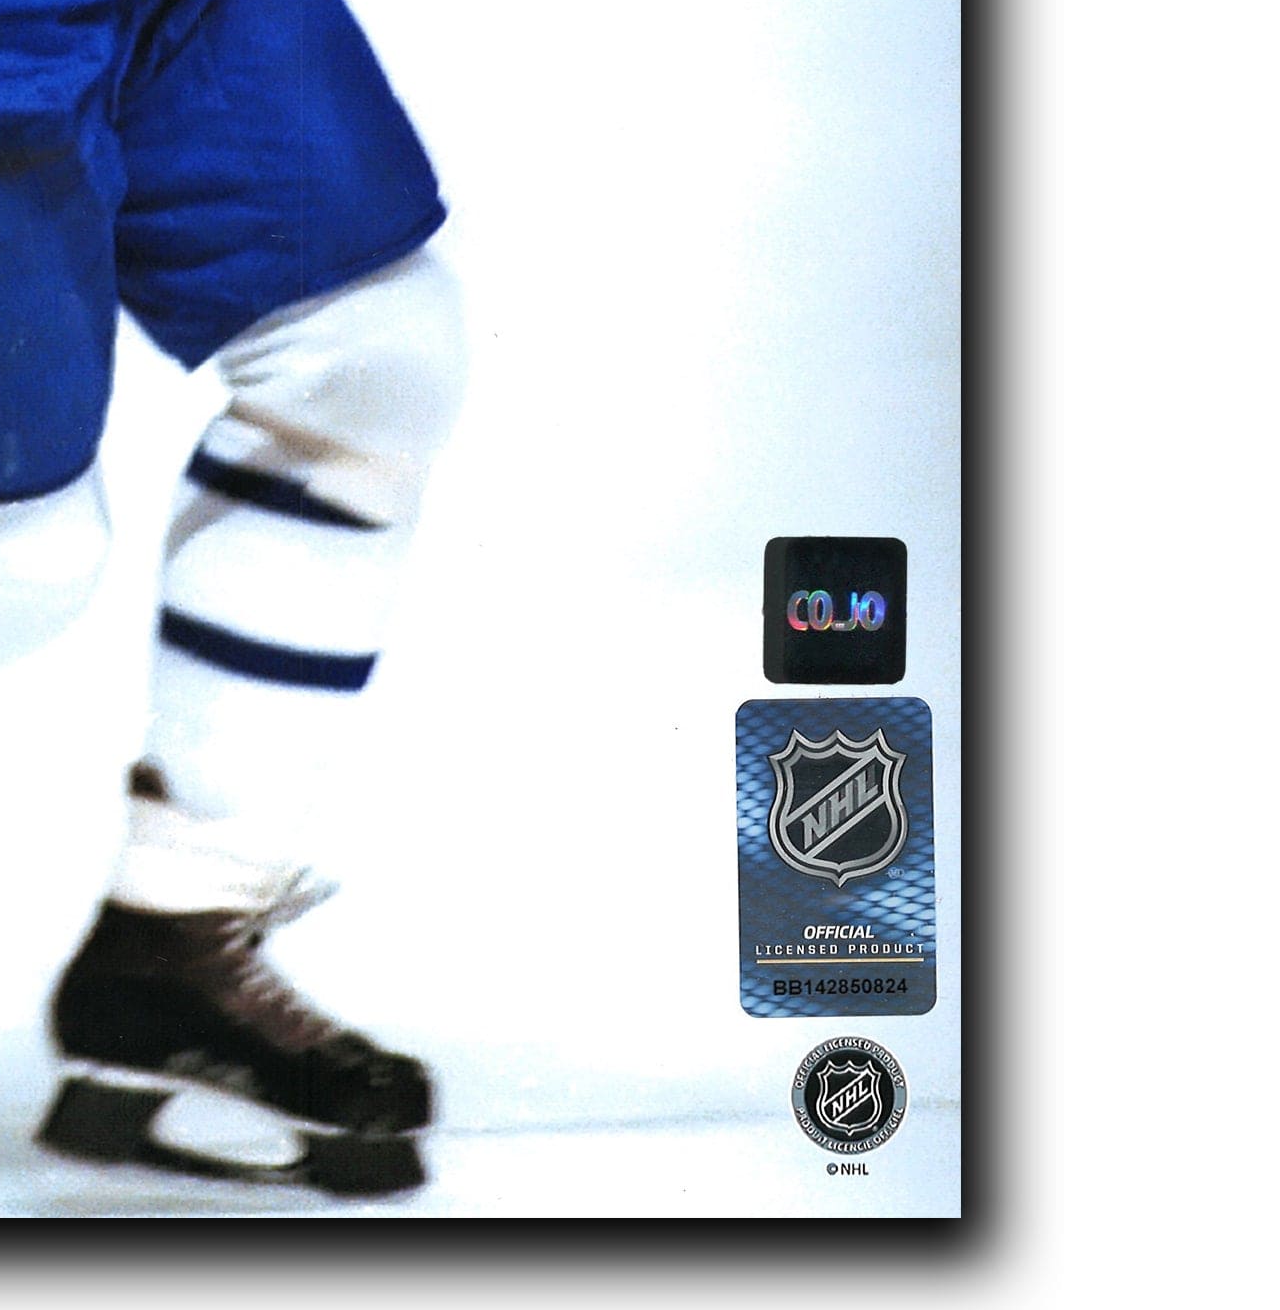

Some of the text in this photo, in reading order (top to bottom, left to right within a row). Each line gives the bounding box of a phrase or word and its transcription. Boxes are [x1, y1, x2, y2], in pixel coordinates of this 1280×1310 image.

[787, 590, 886, 631] COJO
[800, 764, 879, 850] NHL
[804, 925, 875, 940] OFFICIAL
[755, 943, 925, 956] LICENSED PRODUCT
[773, 978, 909, 996] BB142850824
